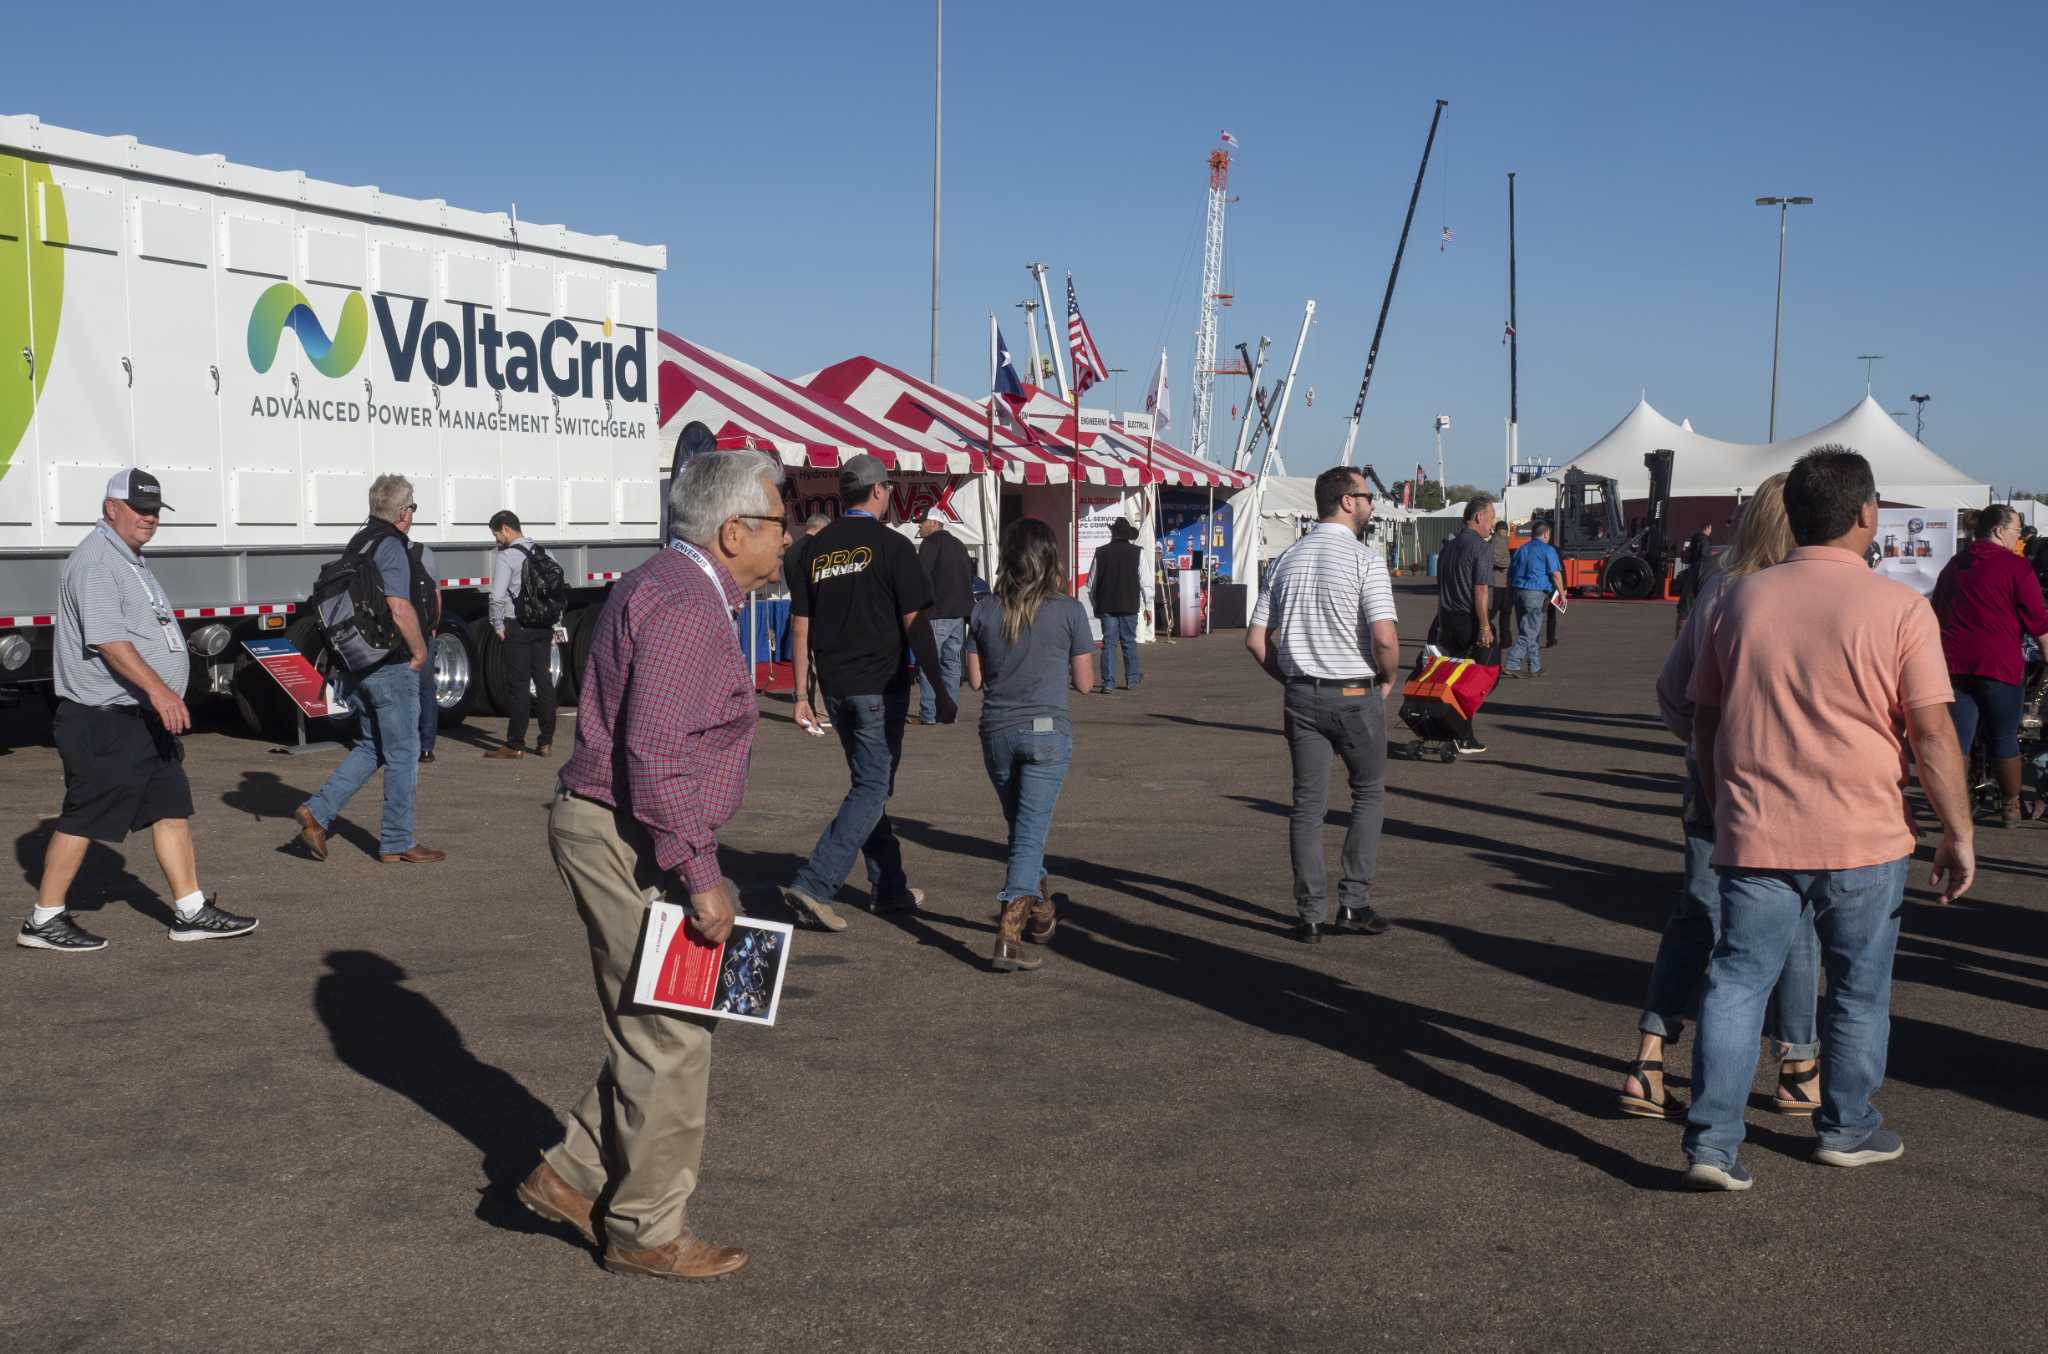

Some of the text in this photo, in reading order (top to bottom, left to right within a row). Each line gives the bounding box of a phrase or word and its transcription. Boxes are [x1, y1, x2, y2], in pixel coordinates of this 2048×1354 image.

[371, 294, 647, 402] VoltaGrid
[251, 395, 646, 439] ADVANCED POWER MANAGEMENT SWITCHGEAR
[1080, 417, 1108, 426] ENGINEERING
[1127, 420, 1149, 429] ELECTRICAL
[1512, 465, 1538, 473] WATSON
[674, 541, 708, 568] ENVERUS
[811, 546, 873, 583] PRO
